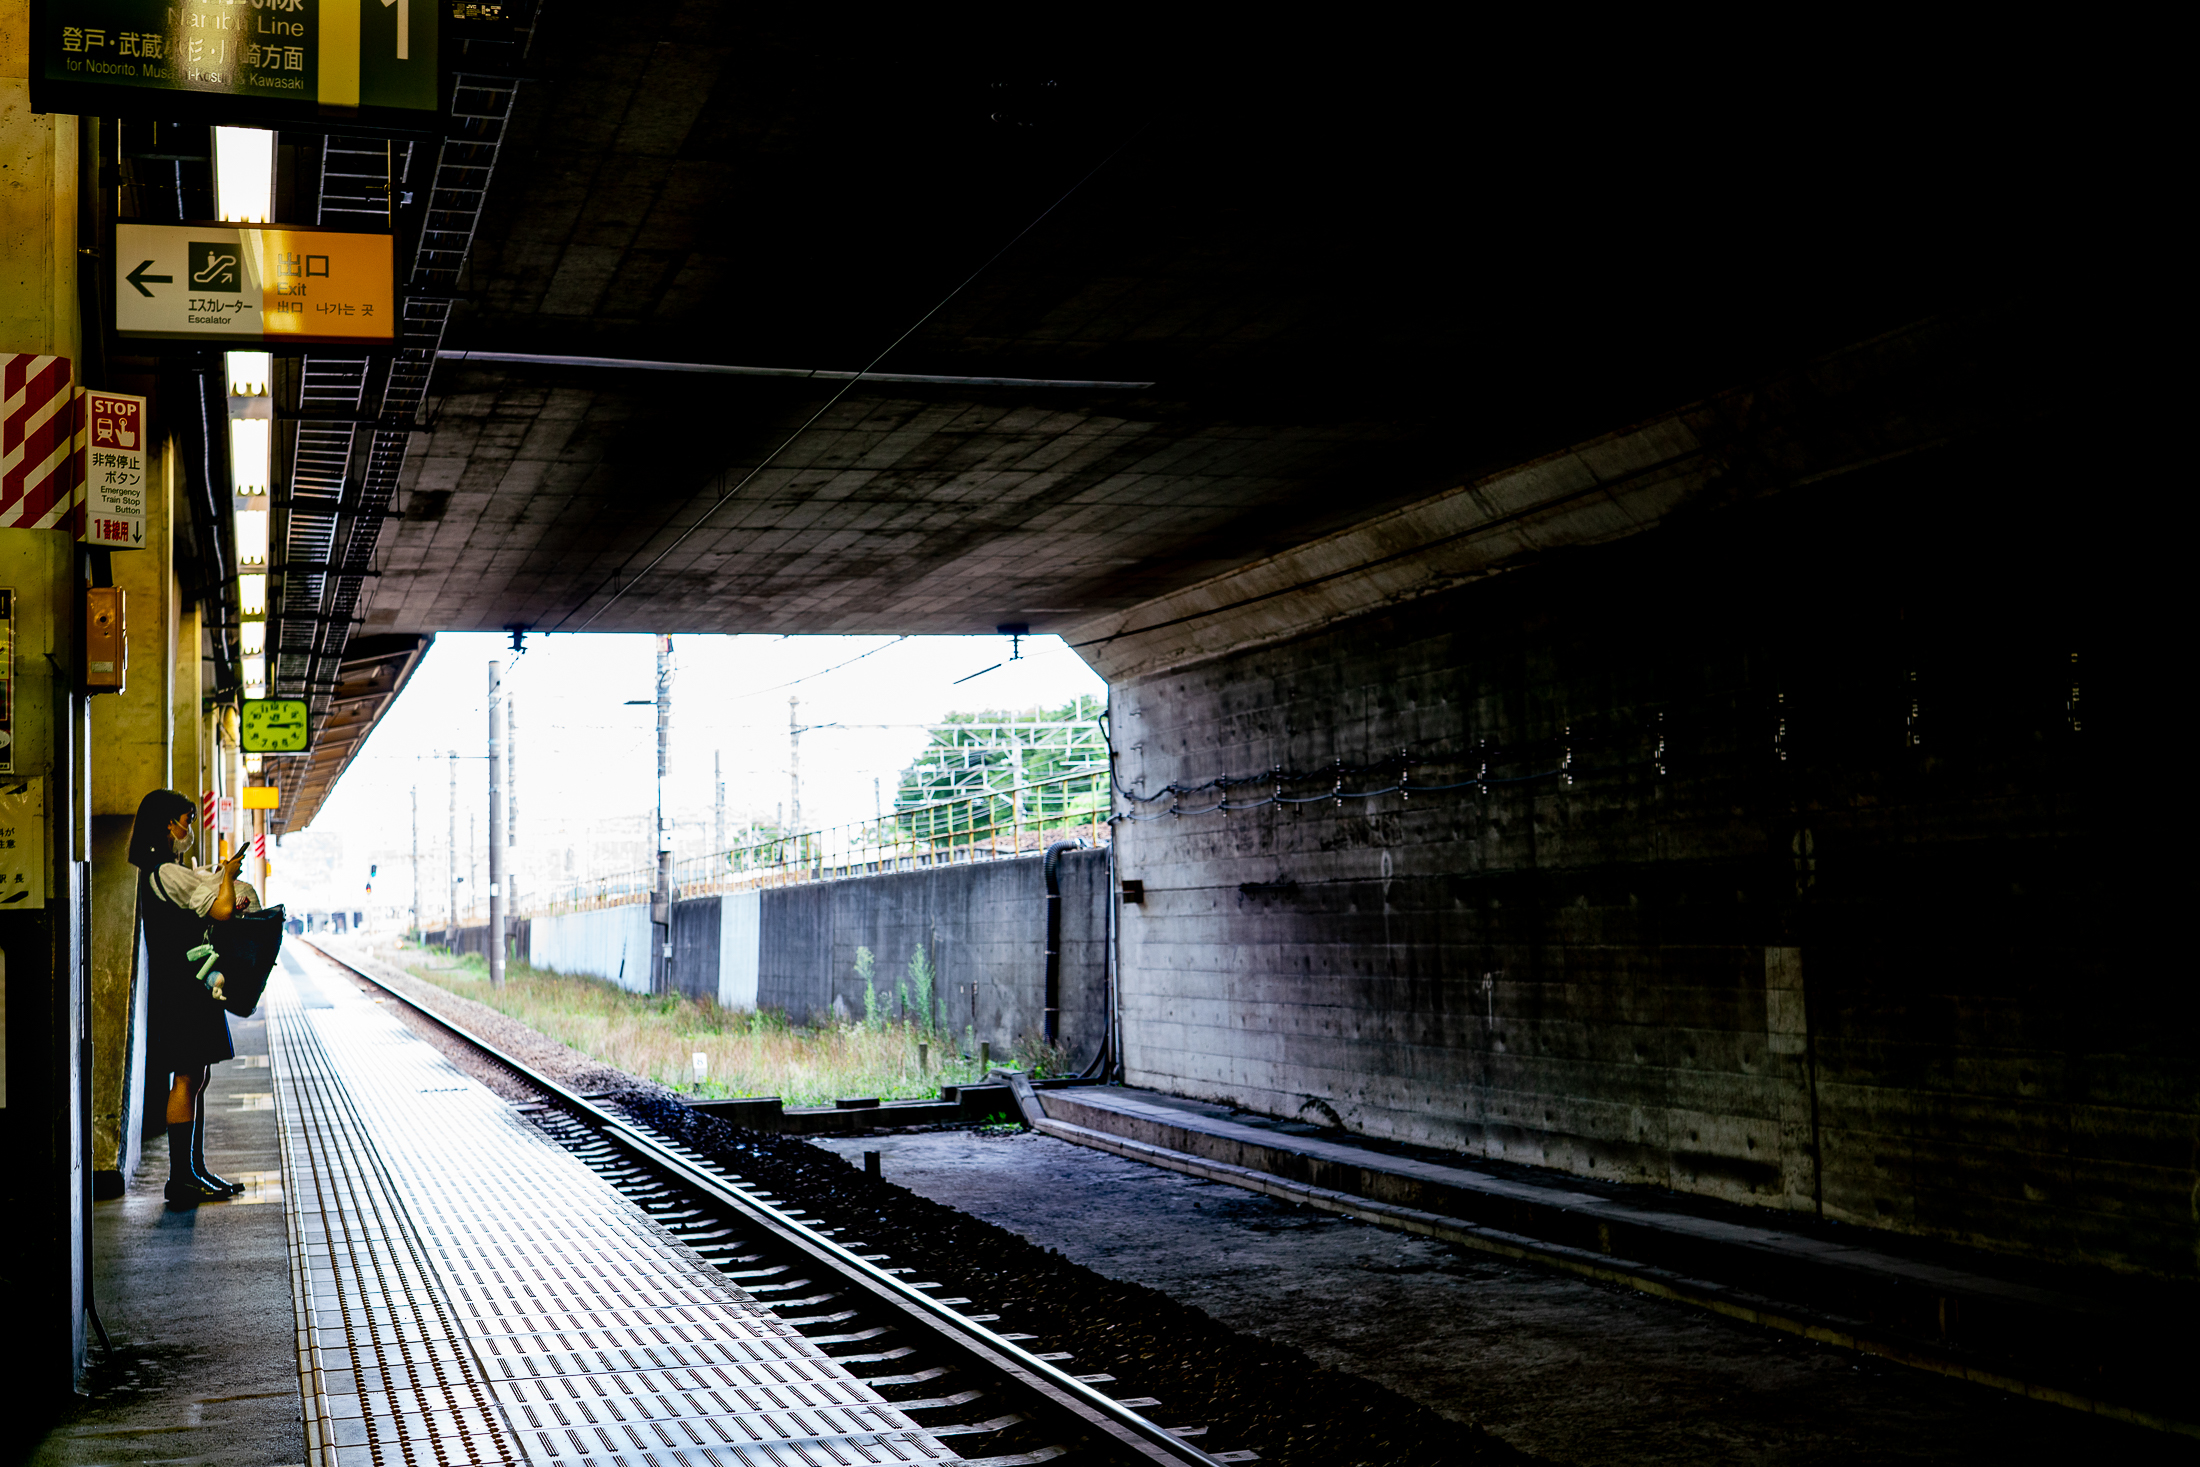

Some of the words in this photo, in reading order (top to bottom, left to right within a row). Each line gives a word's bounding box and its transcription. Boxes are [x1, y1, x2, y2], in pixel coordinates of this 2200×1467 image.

[258, 15, 304, 37] Line
[66, 56, 82, 72] for
[86, 58, 138, 78] Noborito,
[250, 72, 304, 90] Kawasaki
[276, 252, 330, 278] 出口
[277, 282, 306, 297] Exit
[188, 298, 253, 314] エスカレーター
[277, 301, 303, 314] 出口
[316, 302, 356, 316] 나가는
[362, 304, 374, 317] 곳
[188, 314, 231, 325] Escalator
[94, 400, 136, 416] STOP
[92, 453, 140, 470] 非常停止
[105, 470, 140, 486] ボタン
[100, 486, 140, 497] Emergency
[102, 496, 120, 504] Train
[122, 497, 140, 506] Stop
[116, 506, 140, 515] Button
[94, 518, 129, 542] 1番線用
